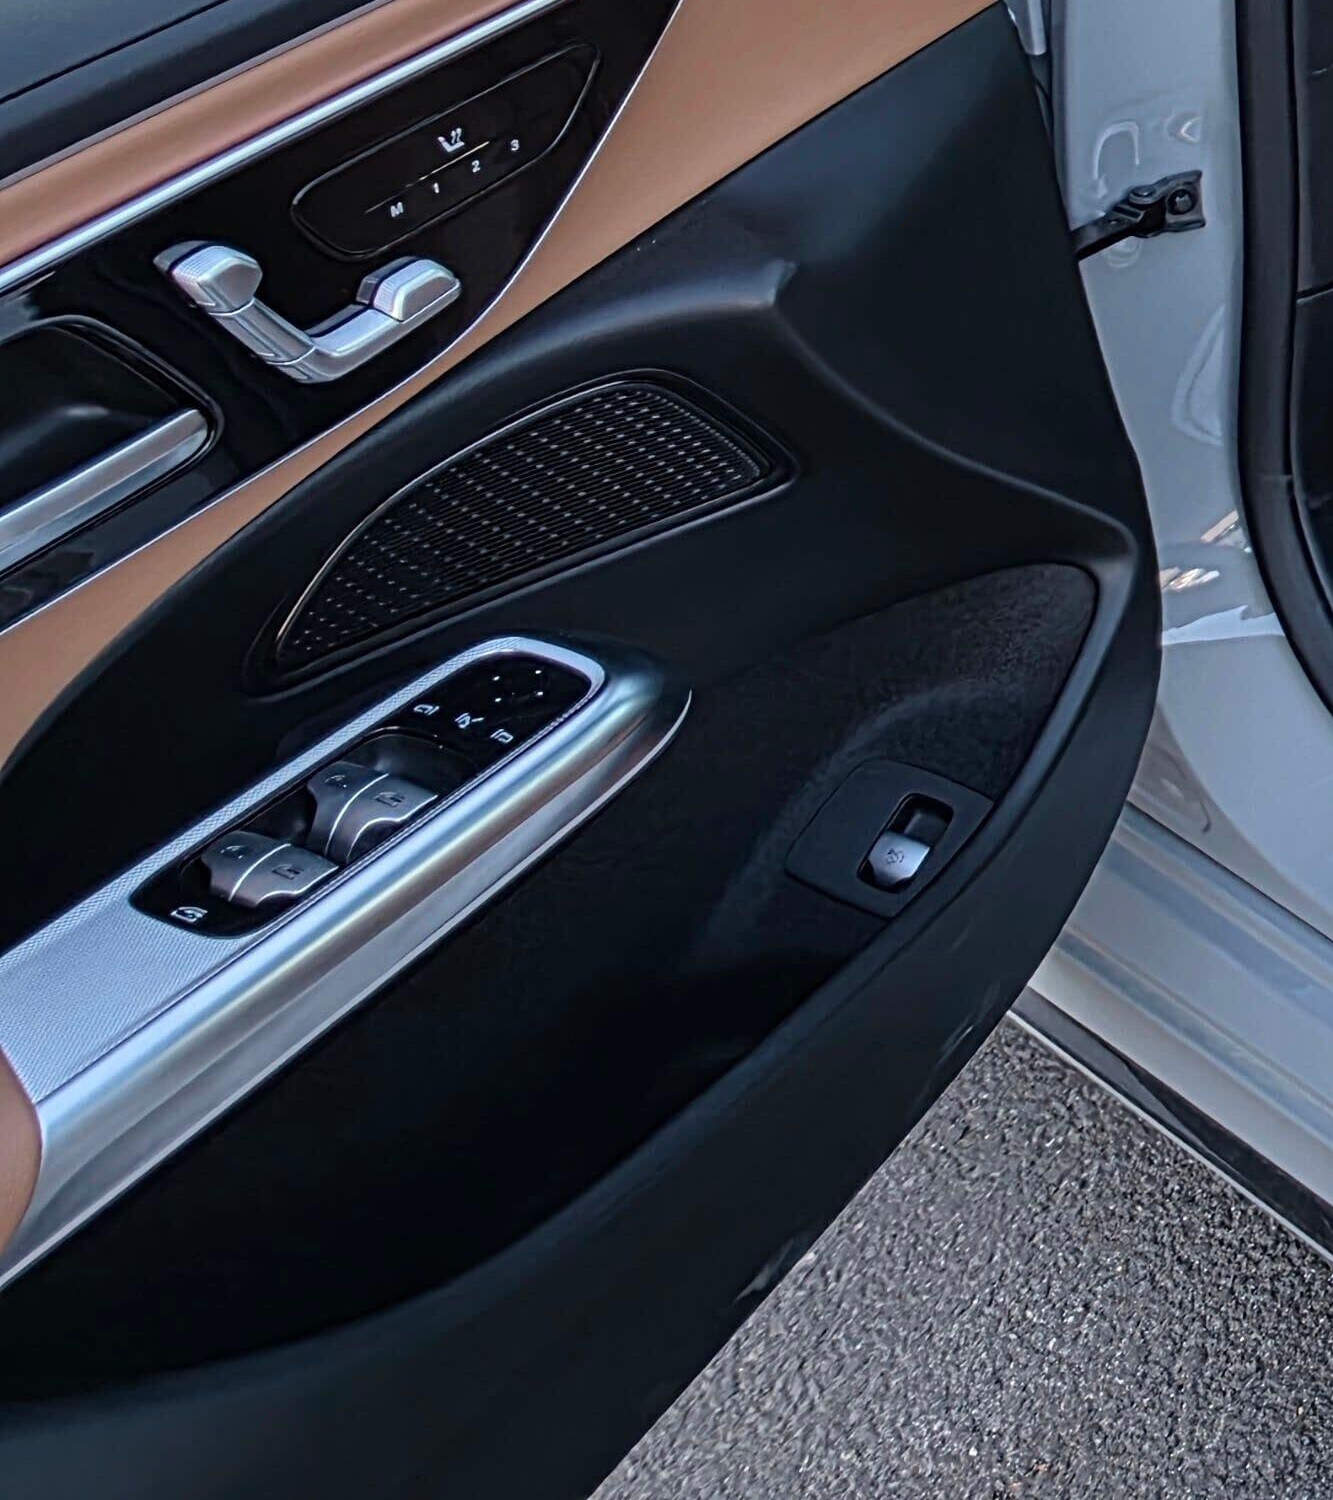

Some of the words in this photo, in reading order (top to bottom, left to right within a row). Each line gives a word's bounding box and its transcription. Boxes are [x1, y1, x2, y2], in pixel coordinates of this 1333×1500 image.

[390, 202, 404, 218] M
[433, 182, 440, 194] 1
[472, 160, 481, 173] 2
[510, 139, 520, 151] 3
